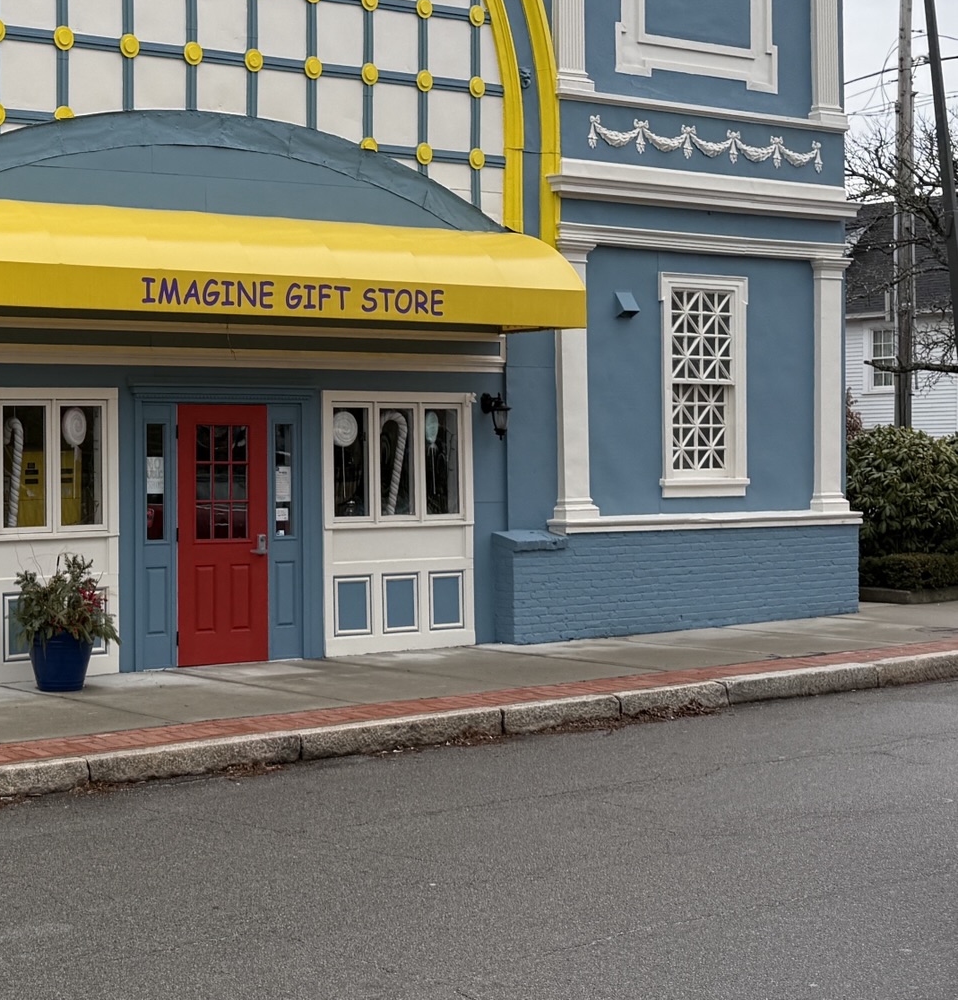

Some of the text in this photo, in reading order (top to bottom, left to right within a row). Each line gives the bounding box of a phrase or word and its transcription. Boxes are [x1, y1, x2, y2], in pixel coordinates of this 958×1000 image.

[141, 277, 445, 317] IMAGINE GIFT STORE
